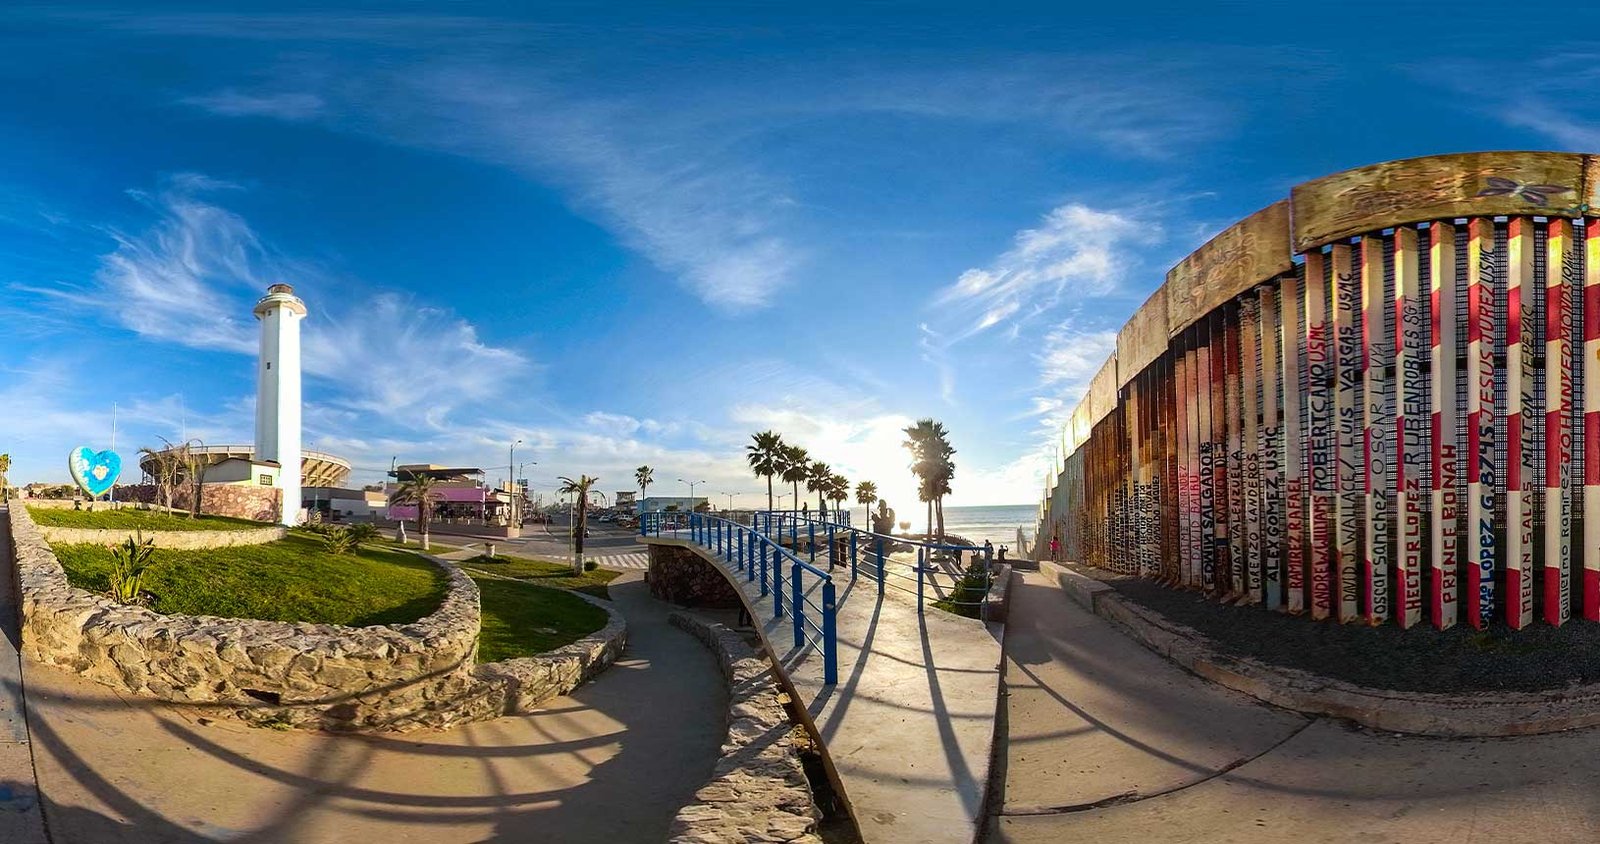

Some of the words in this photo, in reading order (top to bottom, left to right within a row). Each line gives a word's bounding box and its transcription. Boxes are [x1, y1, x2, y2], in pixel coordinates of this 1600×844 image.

[1479, 243, 1496, 284] USMC
[1338, 273, 1352, 311] USMC
[1479, 284, 1495, 345] JUREZ
[1308, 321, 1327, 363] USMC
[1338, 327, 1354, 393] VARGAS
[1520, 303, 1534, 378] TEPEYAC
[1479, 349, 1495, 422] JESUS
[1264, 427, 1279, 471] USMC
[1339, 407, 1353, 448] LUIS
[1371, 404, 1386, 475] OSCAR
[1520, 391, 1534, 468] MILTON
[1179, 465, 1189, 521] HERNANDEZ
[1200, 455, 1213, 529] SALGADO
[1229, 450, 1242, 540] VALENZUELA
[1247, 453, 1260, 523] LANDEROS
[1265, 476, 1279, 537] GOMEZ
[1286, 477, 1302, 531] RAFAEL
[1442, 444, 1457, 520] BONAH
[1190, 521, 1201, 560] DAVID
[1521, 482, 1532, 545] SALAS
[1146, 549, 1154, 572] ARMY
[1153, 552, 1161, 571] ARMY
[1202, 533, 1214, 585] EDWIN
[1231, 546, 1243, 580] JUAN
[1266, 538, 1279, 583] ALEX
[1287, 533, 1303, 589] RAMIREZ
[1342, 549, 1356, 563] J.
[1342, 566, 1357, 602] DAVID
[1442, 528, 1457, 604] PRINCE
[1521, 553, 1532, 614] MELVIN
